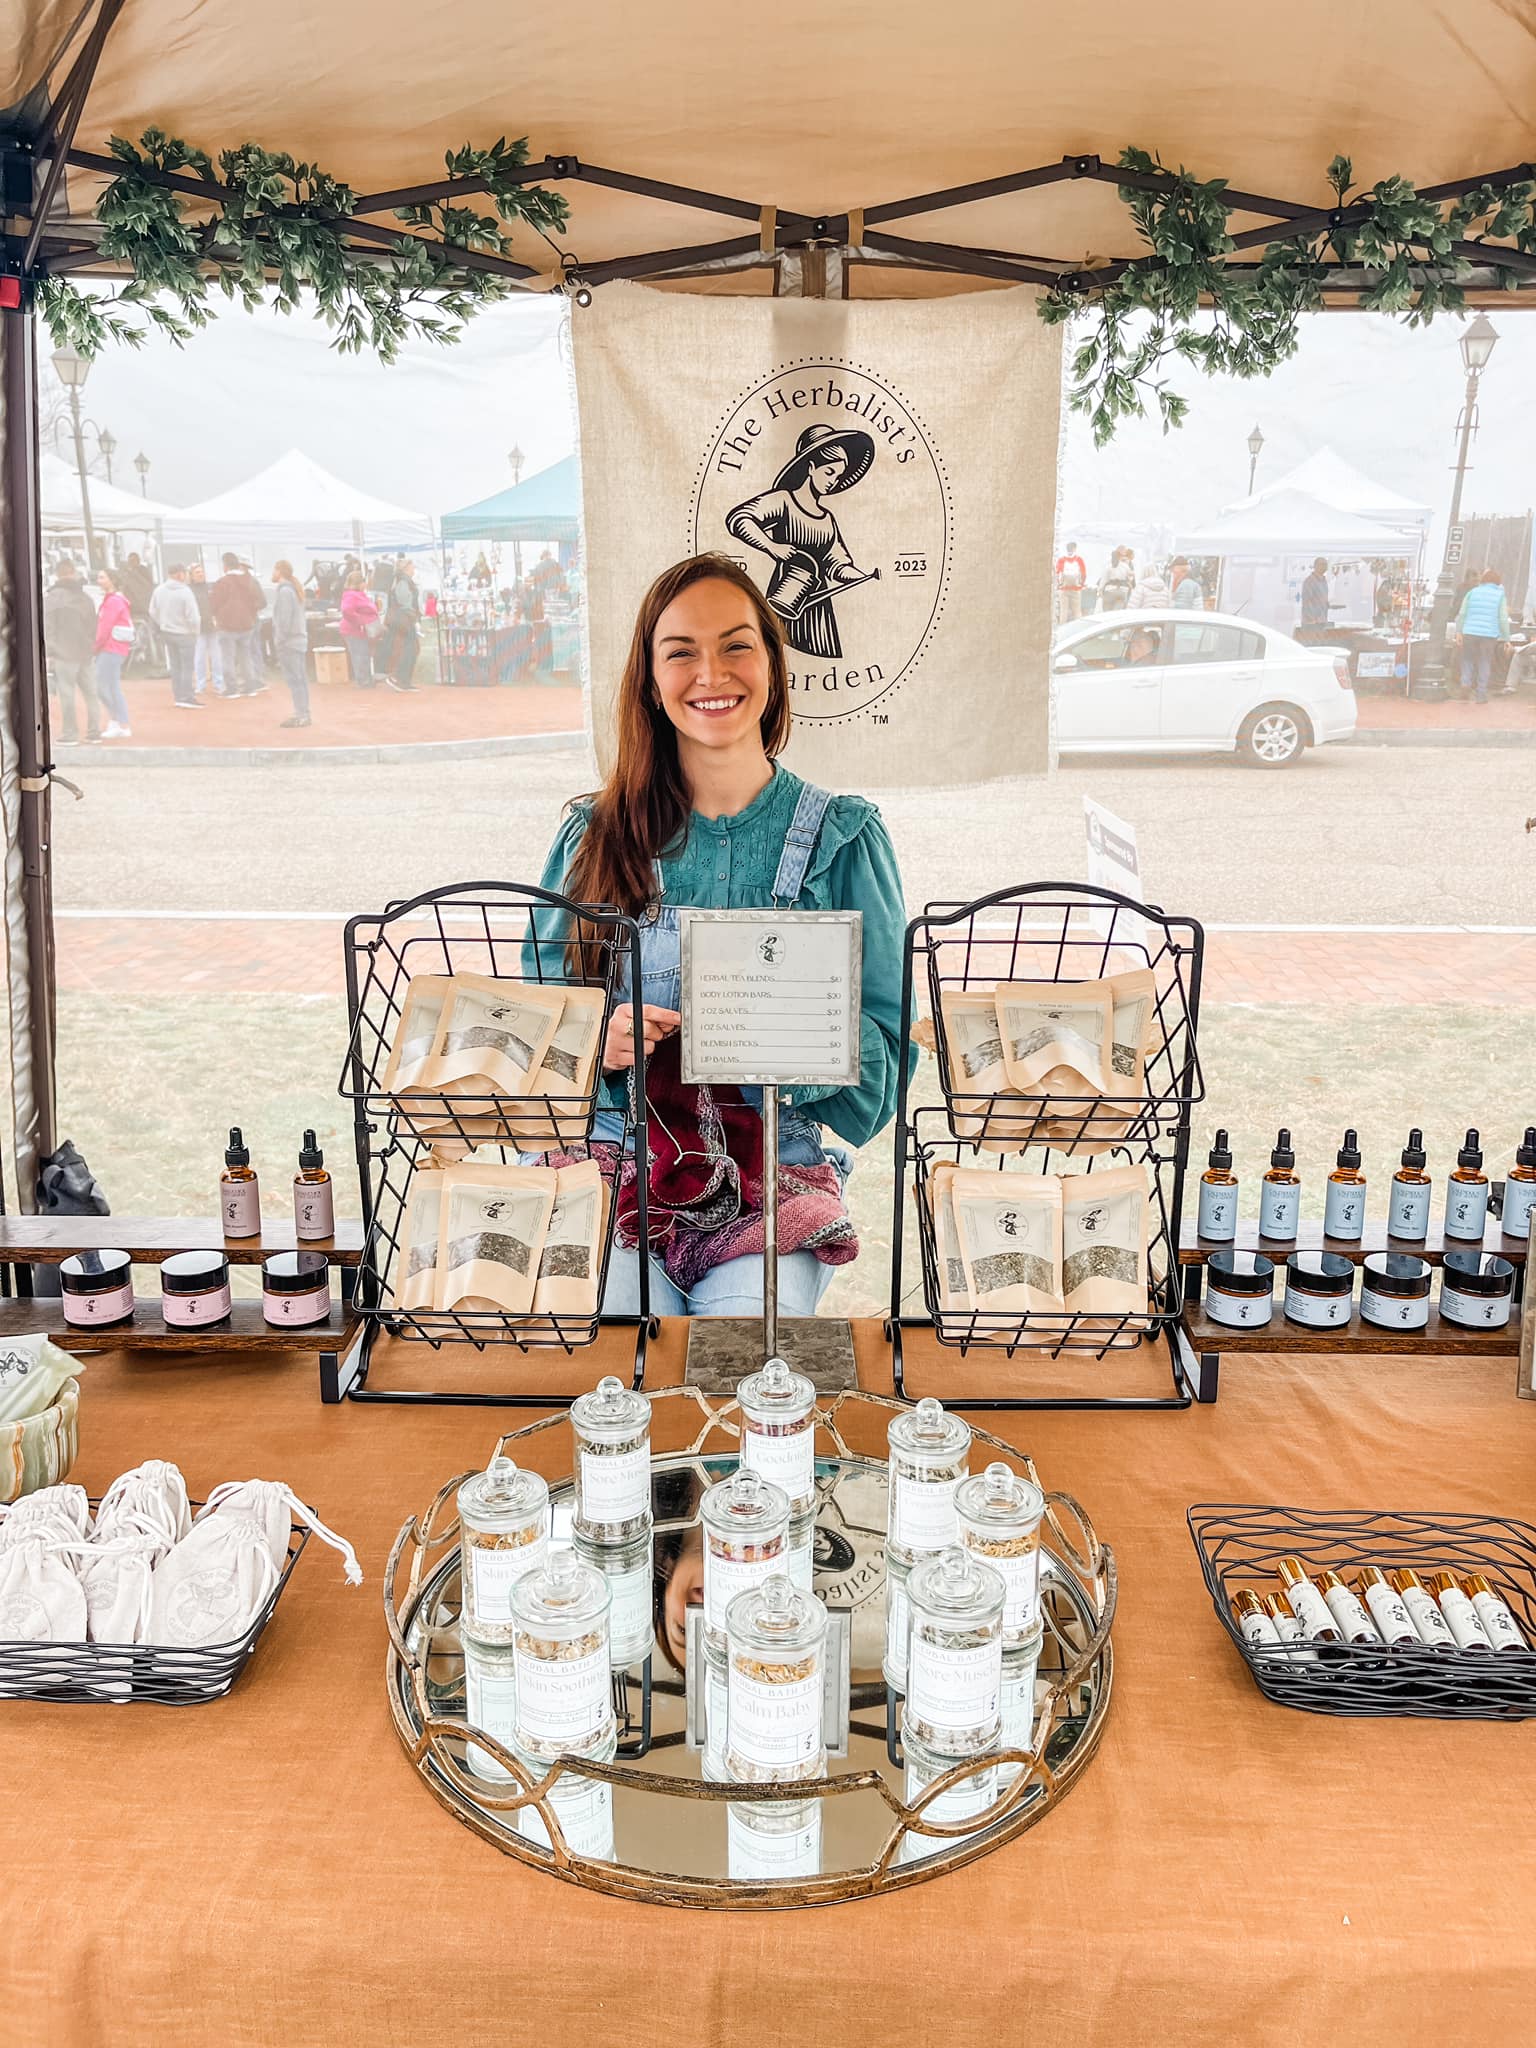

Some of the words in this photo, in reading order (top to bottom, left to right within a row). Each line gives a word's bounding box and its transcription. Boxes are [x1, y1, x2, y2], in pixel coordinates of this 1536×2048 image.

[716, 417, 763, 473] The
[761, 379, 917, 465] Herbalist's
[894, 559, 927, 572] 2023
[786, 663, 886, 692] arden
[871, 714, 889, 725] TM
